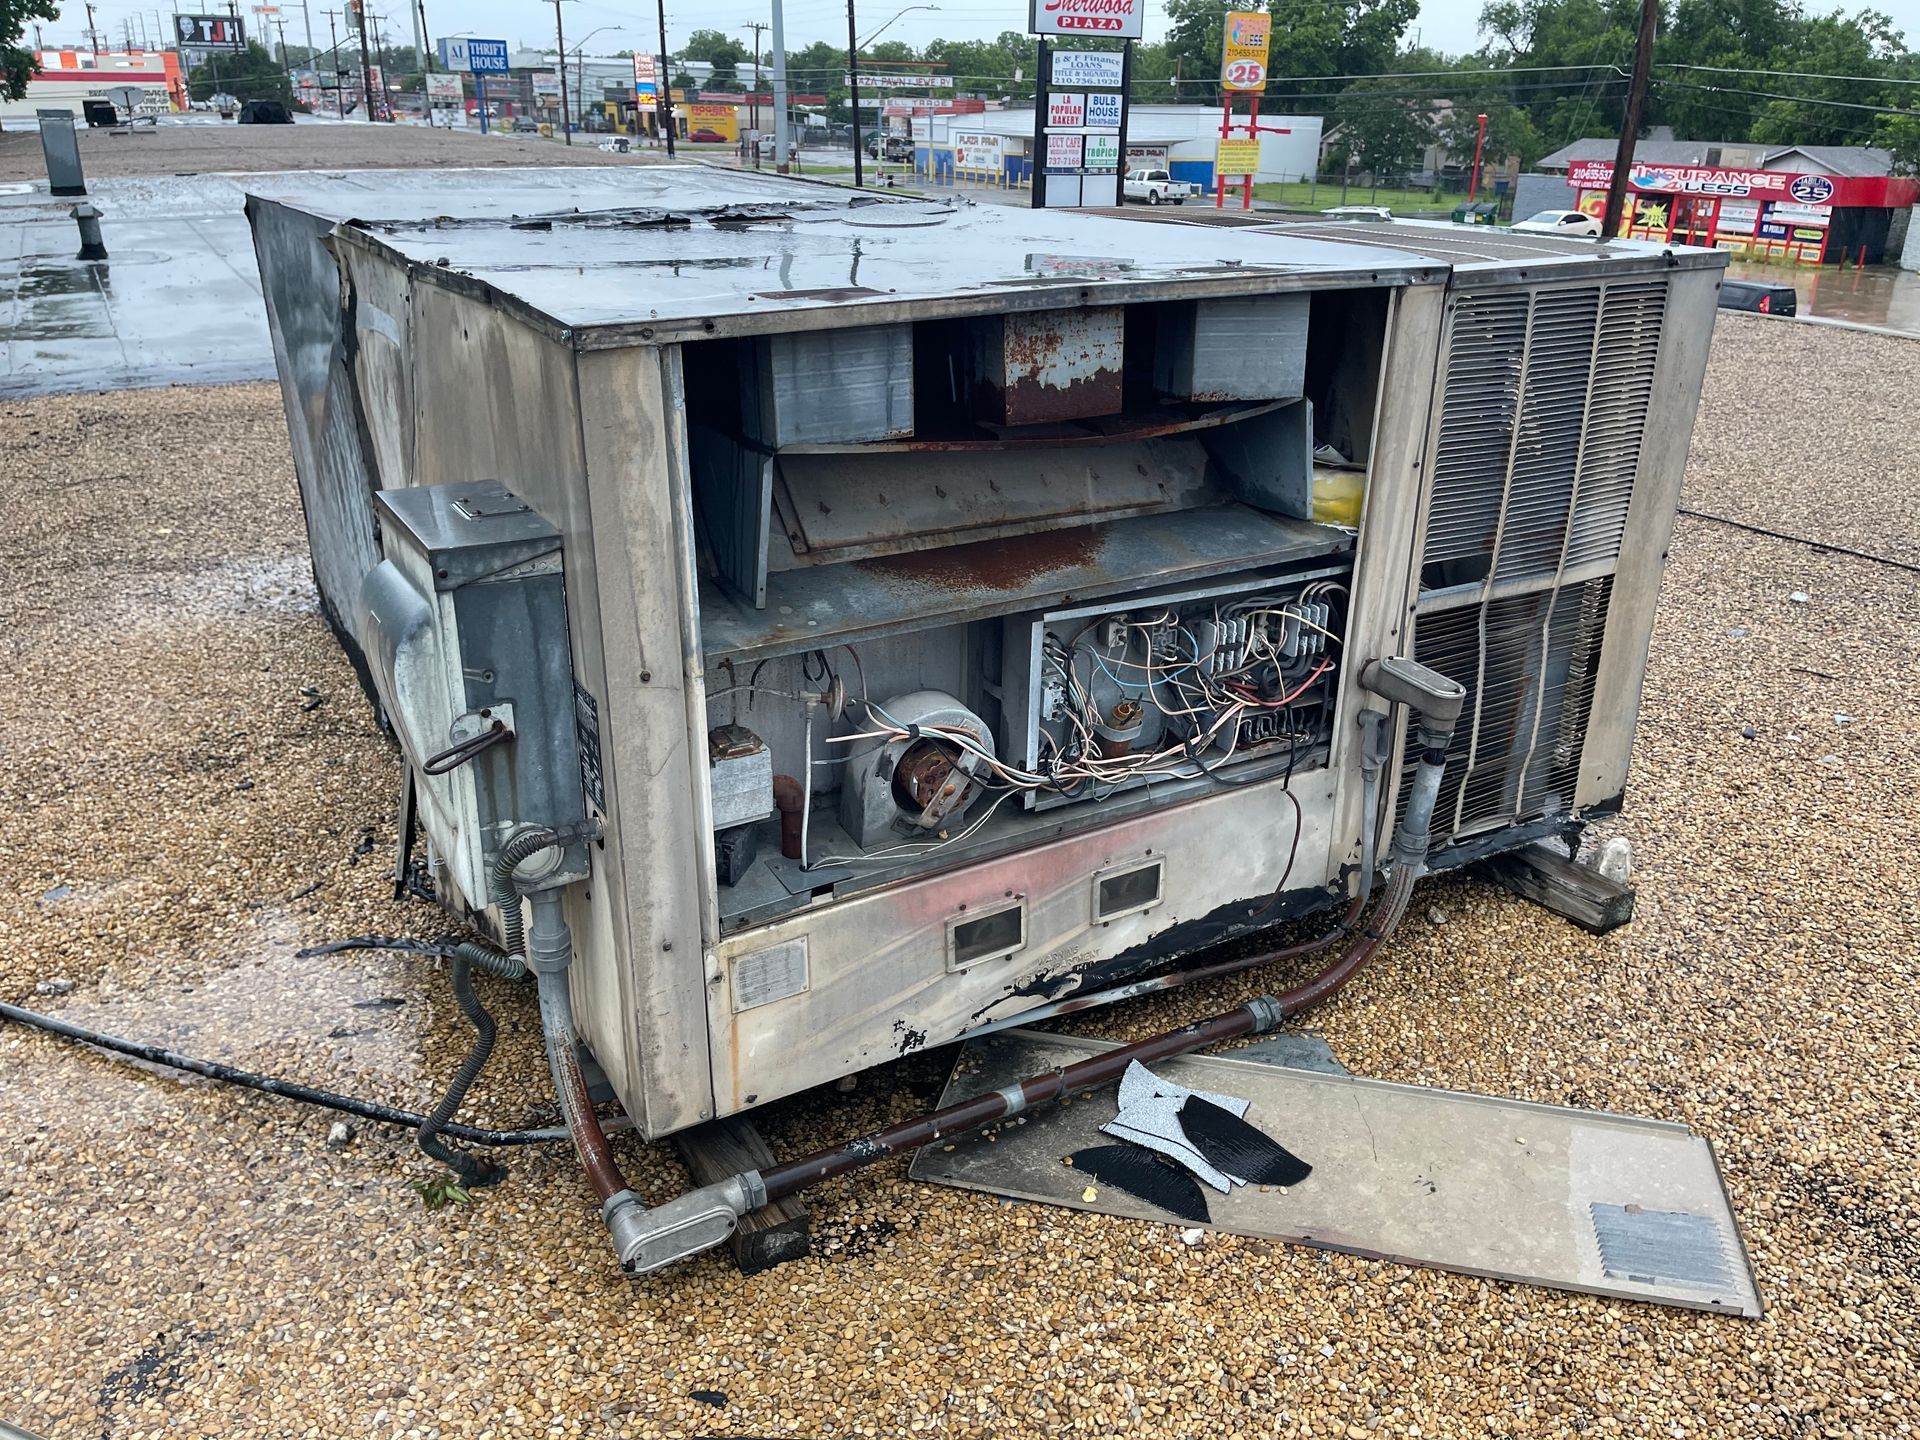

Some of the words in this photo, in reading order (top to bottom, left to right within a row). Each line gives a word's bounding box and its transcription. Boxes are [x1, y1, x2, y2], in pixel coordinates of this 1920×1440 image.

[1062, 17, 1119, 29] PLAZA
[199, 20, 240, 42] TJH
[469, 43, 506, 56] THRIFT
[1227, 48, 1267, 57] 210-655-5377
[471, 57, 507, 70] HOUSE
[1070, 61, 1102, 69] LOANS
[1084, 54, 1120, 66] Finance
[1082, 70, 1119, 78] SIGNATURE
[881, 77, 906, 87] PAWN
[912, 99, 948, 107] TRADE
[1063, 95, 1071, 104] LA
[1093, 95, 1116, 106] BULB
[1050, 105, 1082, 115] POPULAR
[1089, 106, 1120, 117] HOUSE
[1052, 115, 1079, 125] BAKERY
[959, 135, 978, 145] PLAZA
[981, 136, 999, 146] PAWN
[1065, 137, 1081, 148] CAFE
[1099, 137, 1106, 146] EL
[1087, 148, 1118, 157] TROPICO
[1146, 149, 1165, 157] PAWN
[1048, 157, 1080, 166] 737-7166
[1572, 167, 1615, 181] 210-655-537
[1635, 164, 1787, 190] INSURANCE
[1662, 181, 1683, 193] 4
[1683, 181, 1751, 197] LESS
